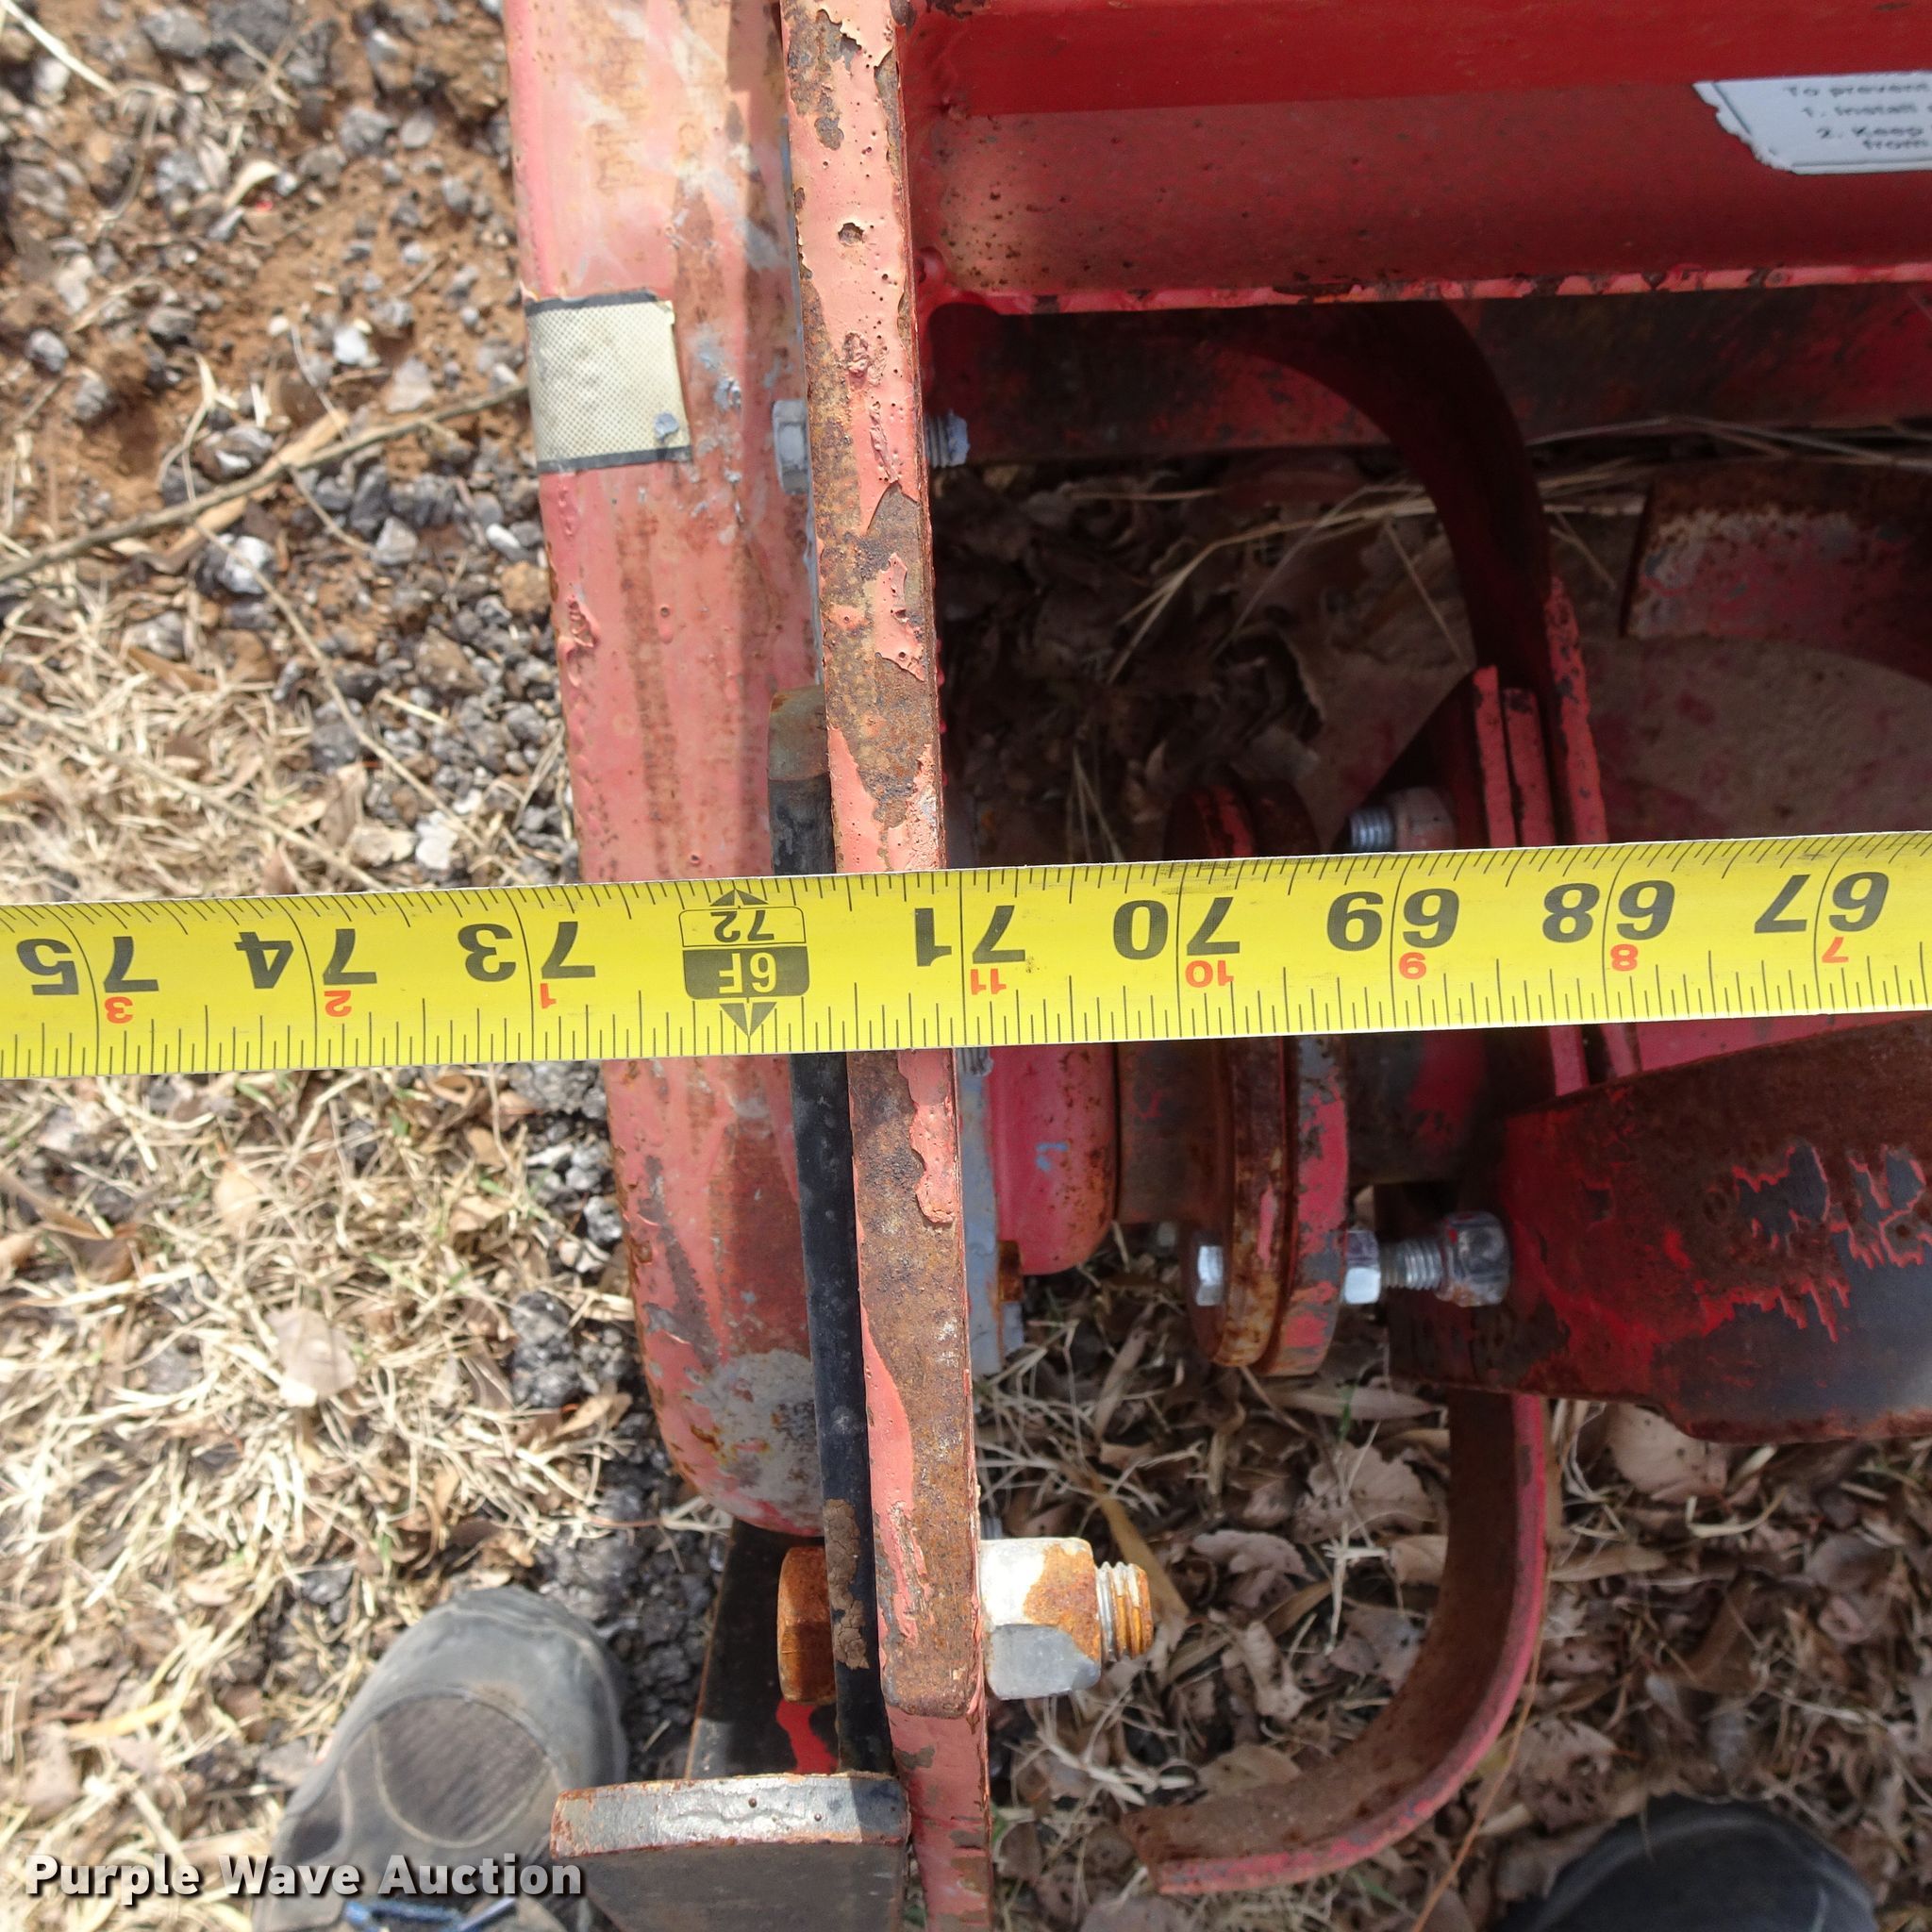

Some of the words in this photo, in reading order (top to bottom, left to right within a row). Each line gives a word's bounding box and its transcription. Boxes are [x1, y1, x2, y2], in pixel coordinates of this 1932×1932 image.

[1784, 86, 1820, 97] To
[1834, 104, 1918, 116] Install
[1851, 125, 1924, 138] Keep
[1541, 879, 1676, 943] 68
[1753, 871, 1890, 934] 67
[712, 909, 775, 943] 72
[1112, 895, 1241, 960] 70
[1325, 888, 1460, 952] 69
[913, 904, 1026, 967] 71
[1821, 936, 1850, 964] 7
[15, 935, 159, 995] 75
[234, 927, 377, 990] 74
[457, 920, 596, 982] 73
[1398, 951, 1427, 980] 9
[1609, 943, 1639, 973] 8
[718, 950, 777, 991] 6F
[970, 967, 1008, 995] 11
[1184, 959, 1234, 988] 10
[104, 996, 134, 1024] 3
[324, 990, 353, 1018] 2
[538, 983, 557, 1009] 1
